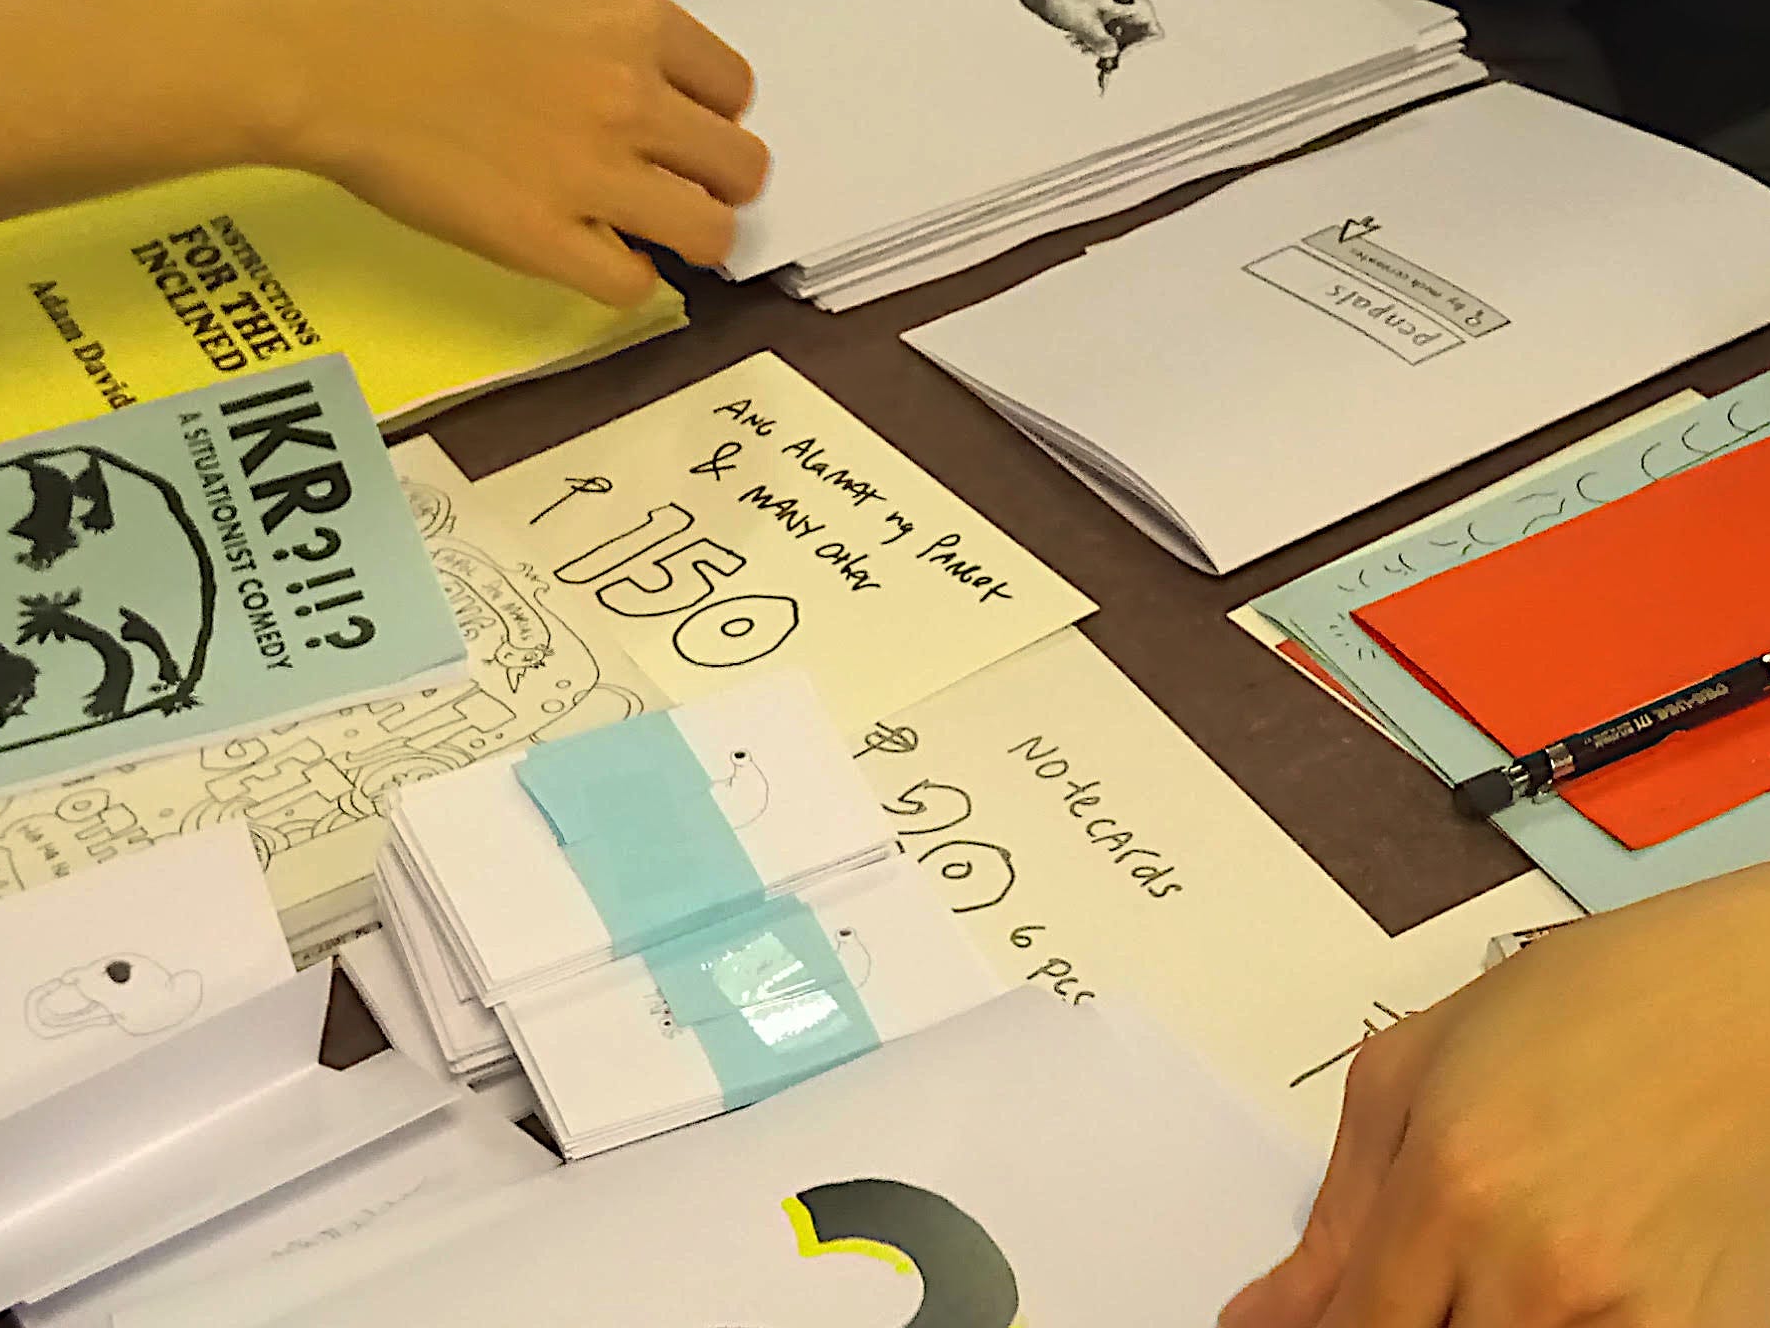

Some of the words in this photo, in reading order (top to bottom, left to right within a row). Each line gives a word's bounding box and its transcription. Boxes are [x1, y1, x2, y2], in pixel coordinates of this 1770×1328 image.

[130, 238, 248, 373] INCLINED
[167, 223, 239, 293] FOR
[220, 289, 293, 362] THE
[209, 214, 322, 347] INSTRUCTIONS
[1325, 283, 1443, 348] penpals
[72, 339, 138, 410] David
[178, 411, 204, 427] A
[183, 426, 258, 573] SITUATIONIST
[219, 379, 377, 651] IKR?!!?
[689, 441, 742, 481] &
[236, 577, 294, 671] COMEDY
[554, 502, 800, 668] 150
[1009, 925, 1046, 949] 6
